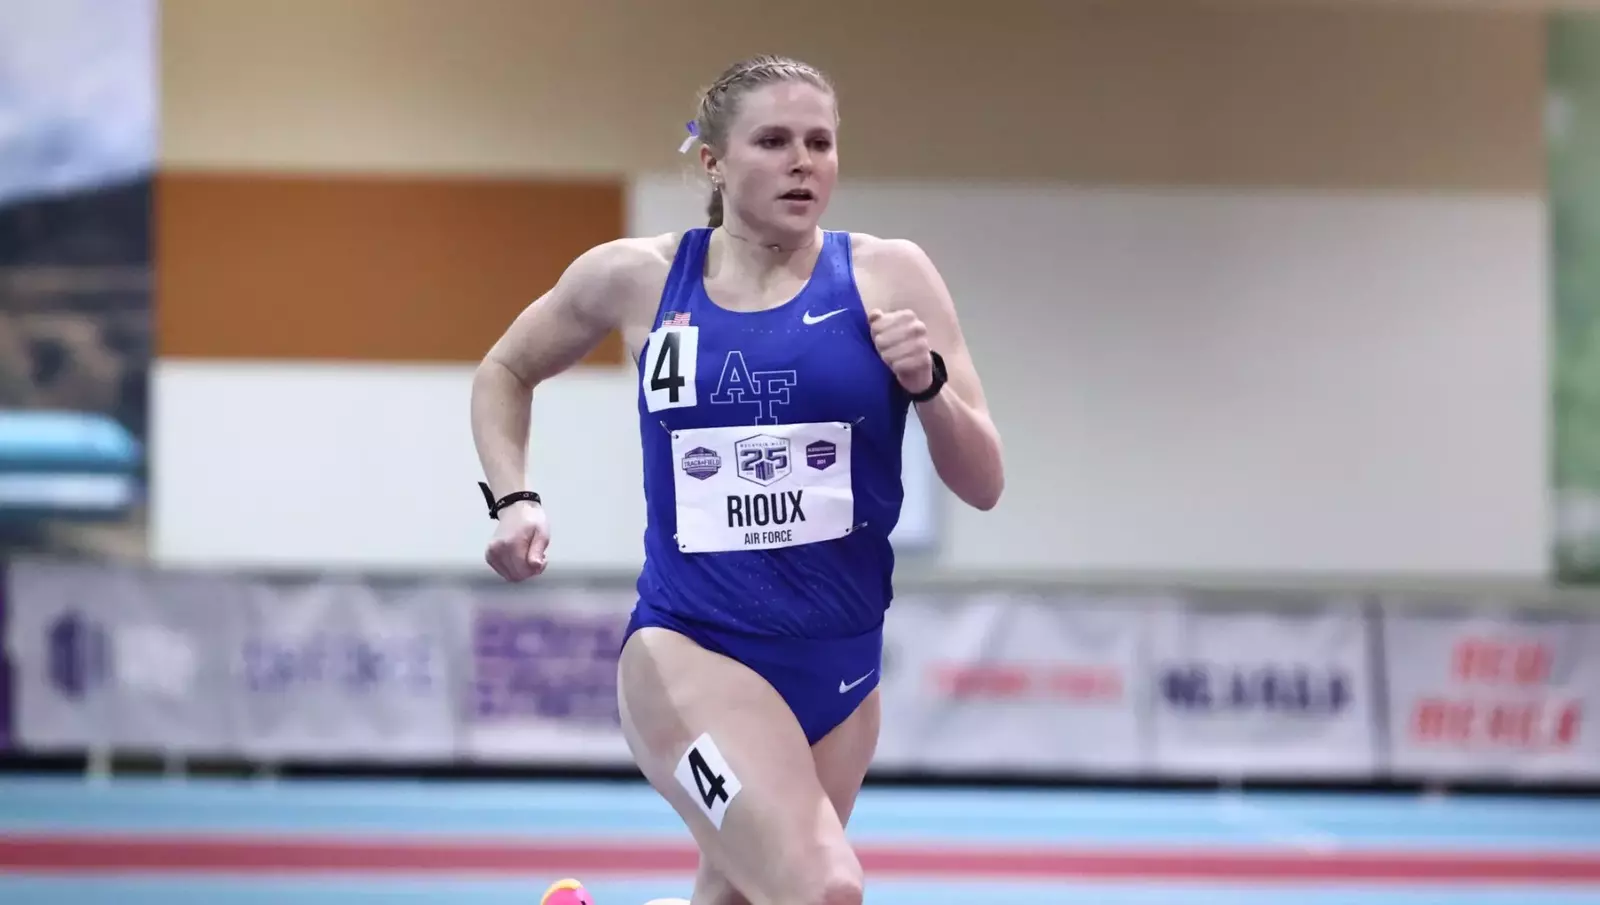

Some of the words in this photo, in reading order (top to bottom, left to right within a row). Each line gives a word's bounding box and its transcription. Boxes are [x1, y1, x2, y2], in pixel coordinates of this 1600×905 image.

[650, 331, 686, 404] 4
[710, 350, 797, 425] AF
[740, 446, 788, 471] 25
[727, 489, 806, 528] RIOUX
[744, 532, 760, 545] AIR
[762, 529, 793, 544] FORCE
[688, 747, 729, 810] 4
